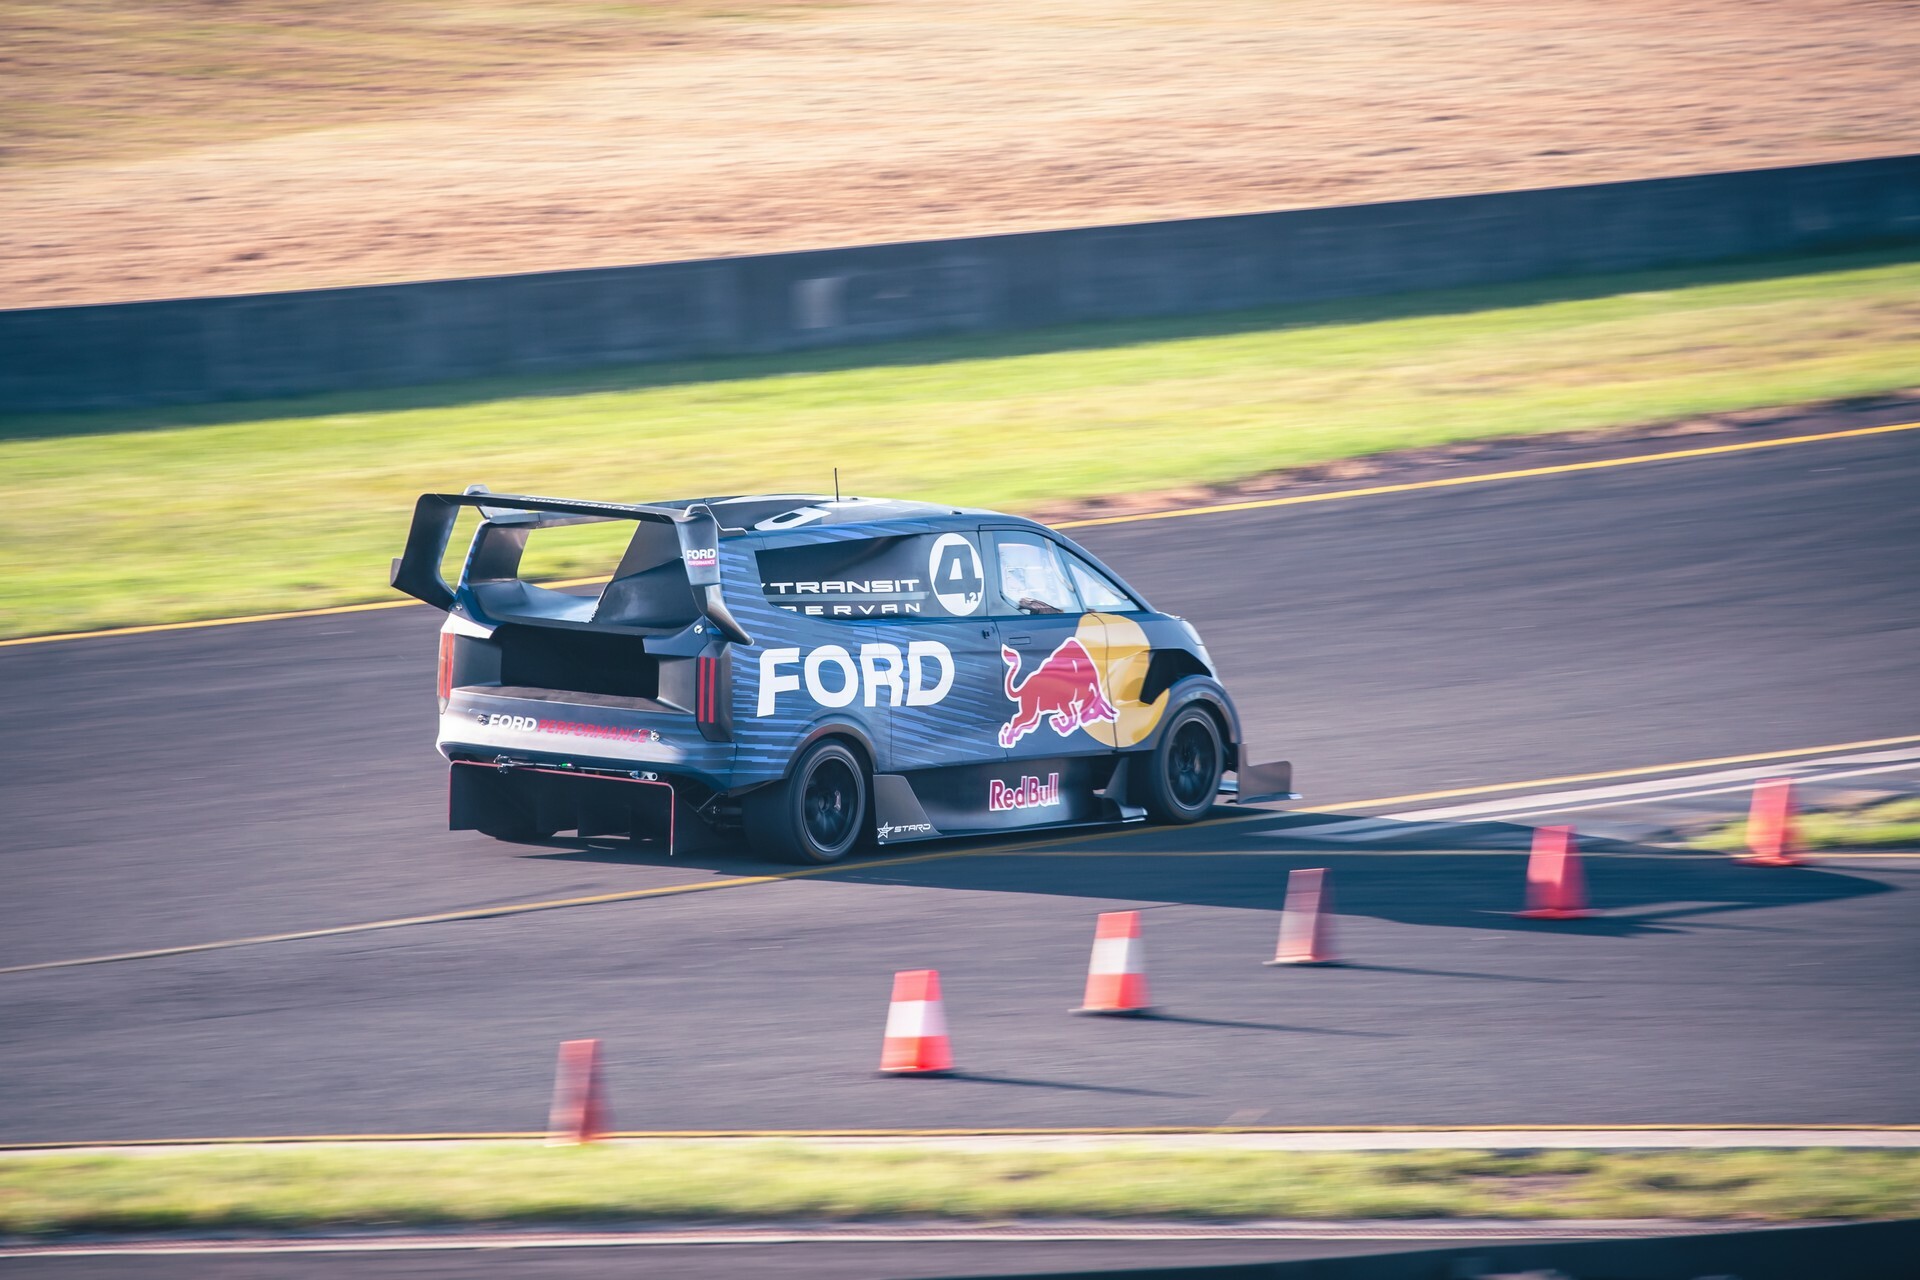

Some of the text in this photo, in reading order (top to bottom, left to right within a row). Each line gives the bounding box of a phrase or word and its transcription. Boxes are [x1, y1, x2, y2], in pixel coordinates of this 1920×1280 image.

[686, 548, 717, 560] FORD
[769, 579, 920, 594] TRANSIT
[757, 640, 956, 718] FORD
[488, 713, 651, 744] FORD PERFORMANCE
[893, 822, 932, 834] STARD
